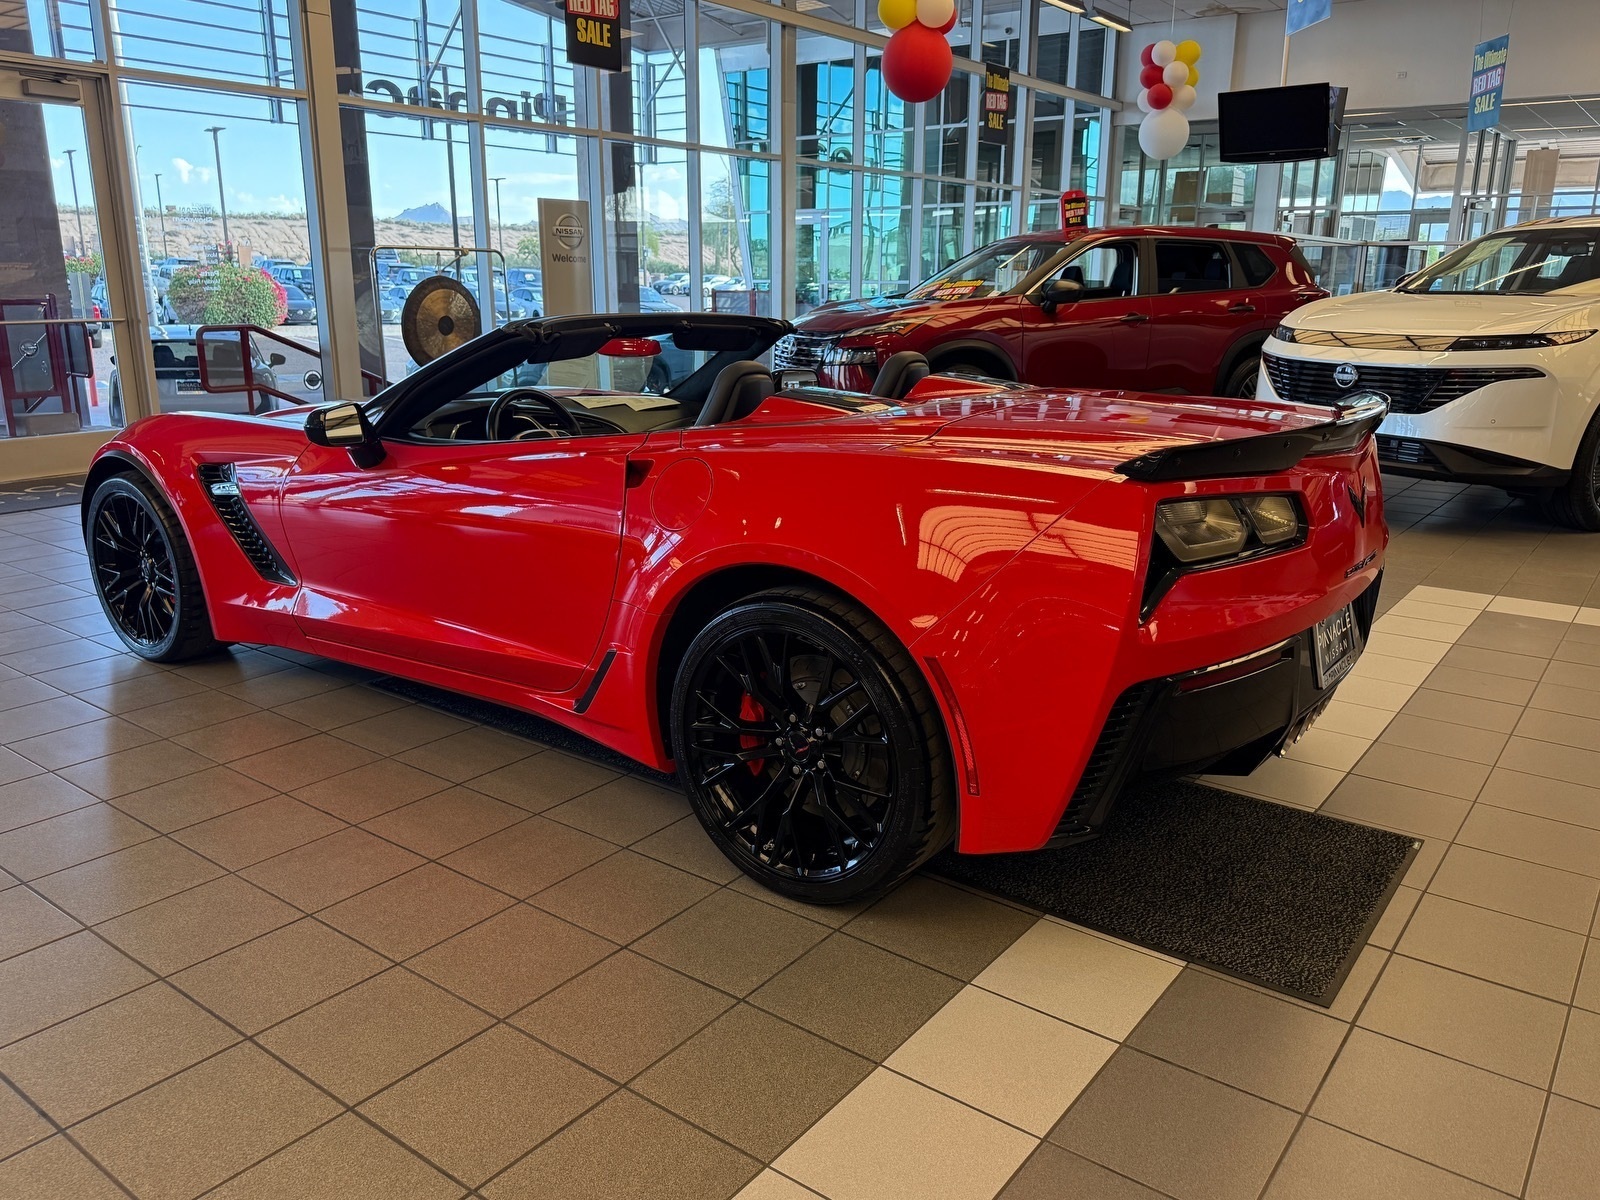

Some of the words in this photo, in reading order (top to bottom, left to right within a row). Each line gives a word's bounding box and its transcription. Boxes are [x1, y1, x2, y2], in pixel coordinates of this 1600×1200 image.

[576, 17, 611, 48] SALE
[1474, 55, 1484, 72] The
[1484, 47, 1506, 69] Ultimate
[1473, 75, 1486, 94] RED
[1487, 68, 1501, 88] TAG
[986, 94, 996, 108] RED
[997, 94, 1007, 109] TAG
[1475, 93, 1496, 114] SALE
[988, 112, 1003, 129] SALE
[1069, 216, 1081, 224] SALE
[552, 254, 586, 263] Welcome
[1324, 639, 1348, 664] NISSAN
